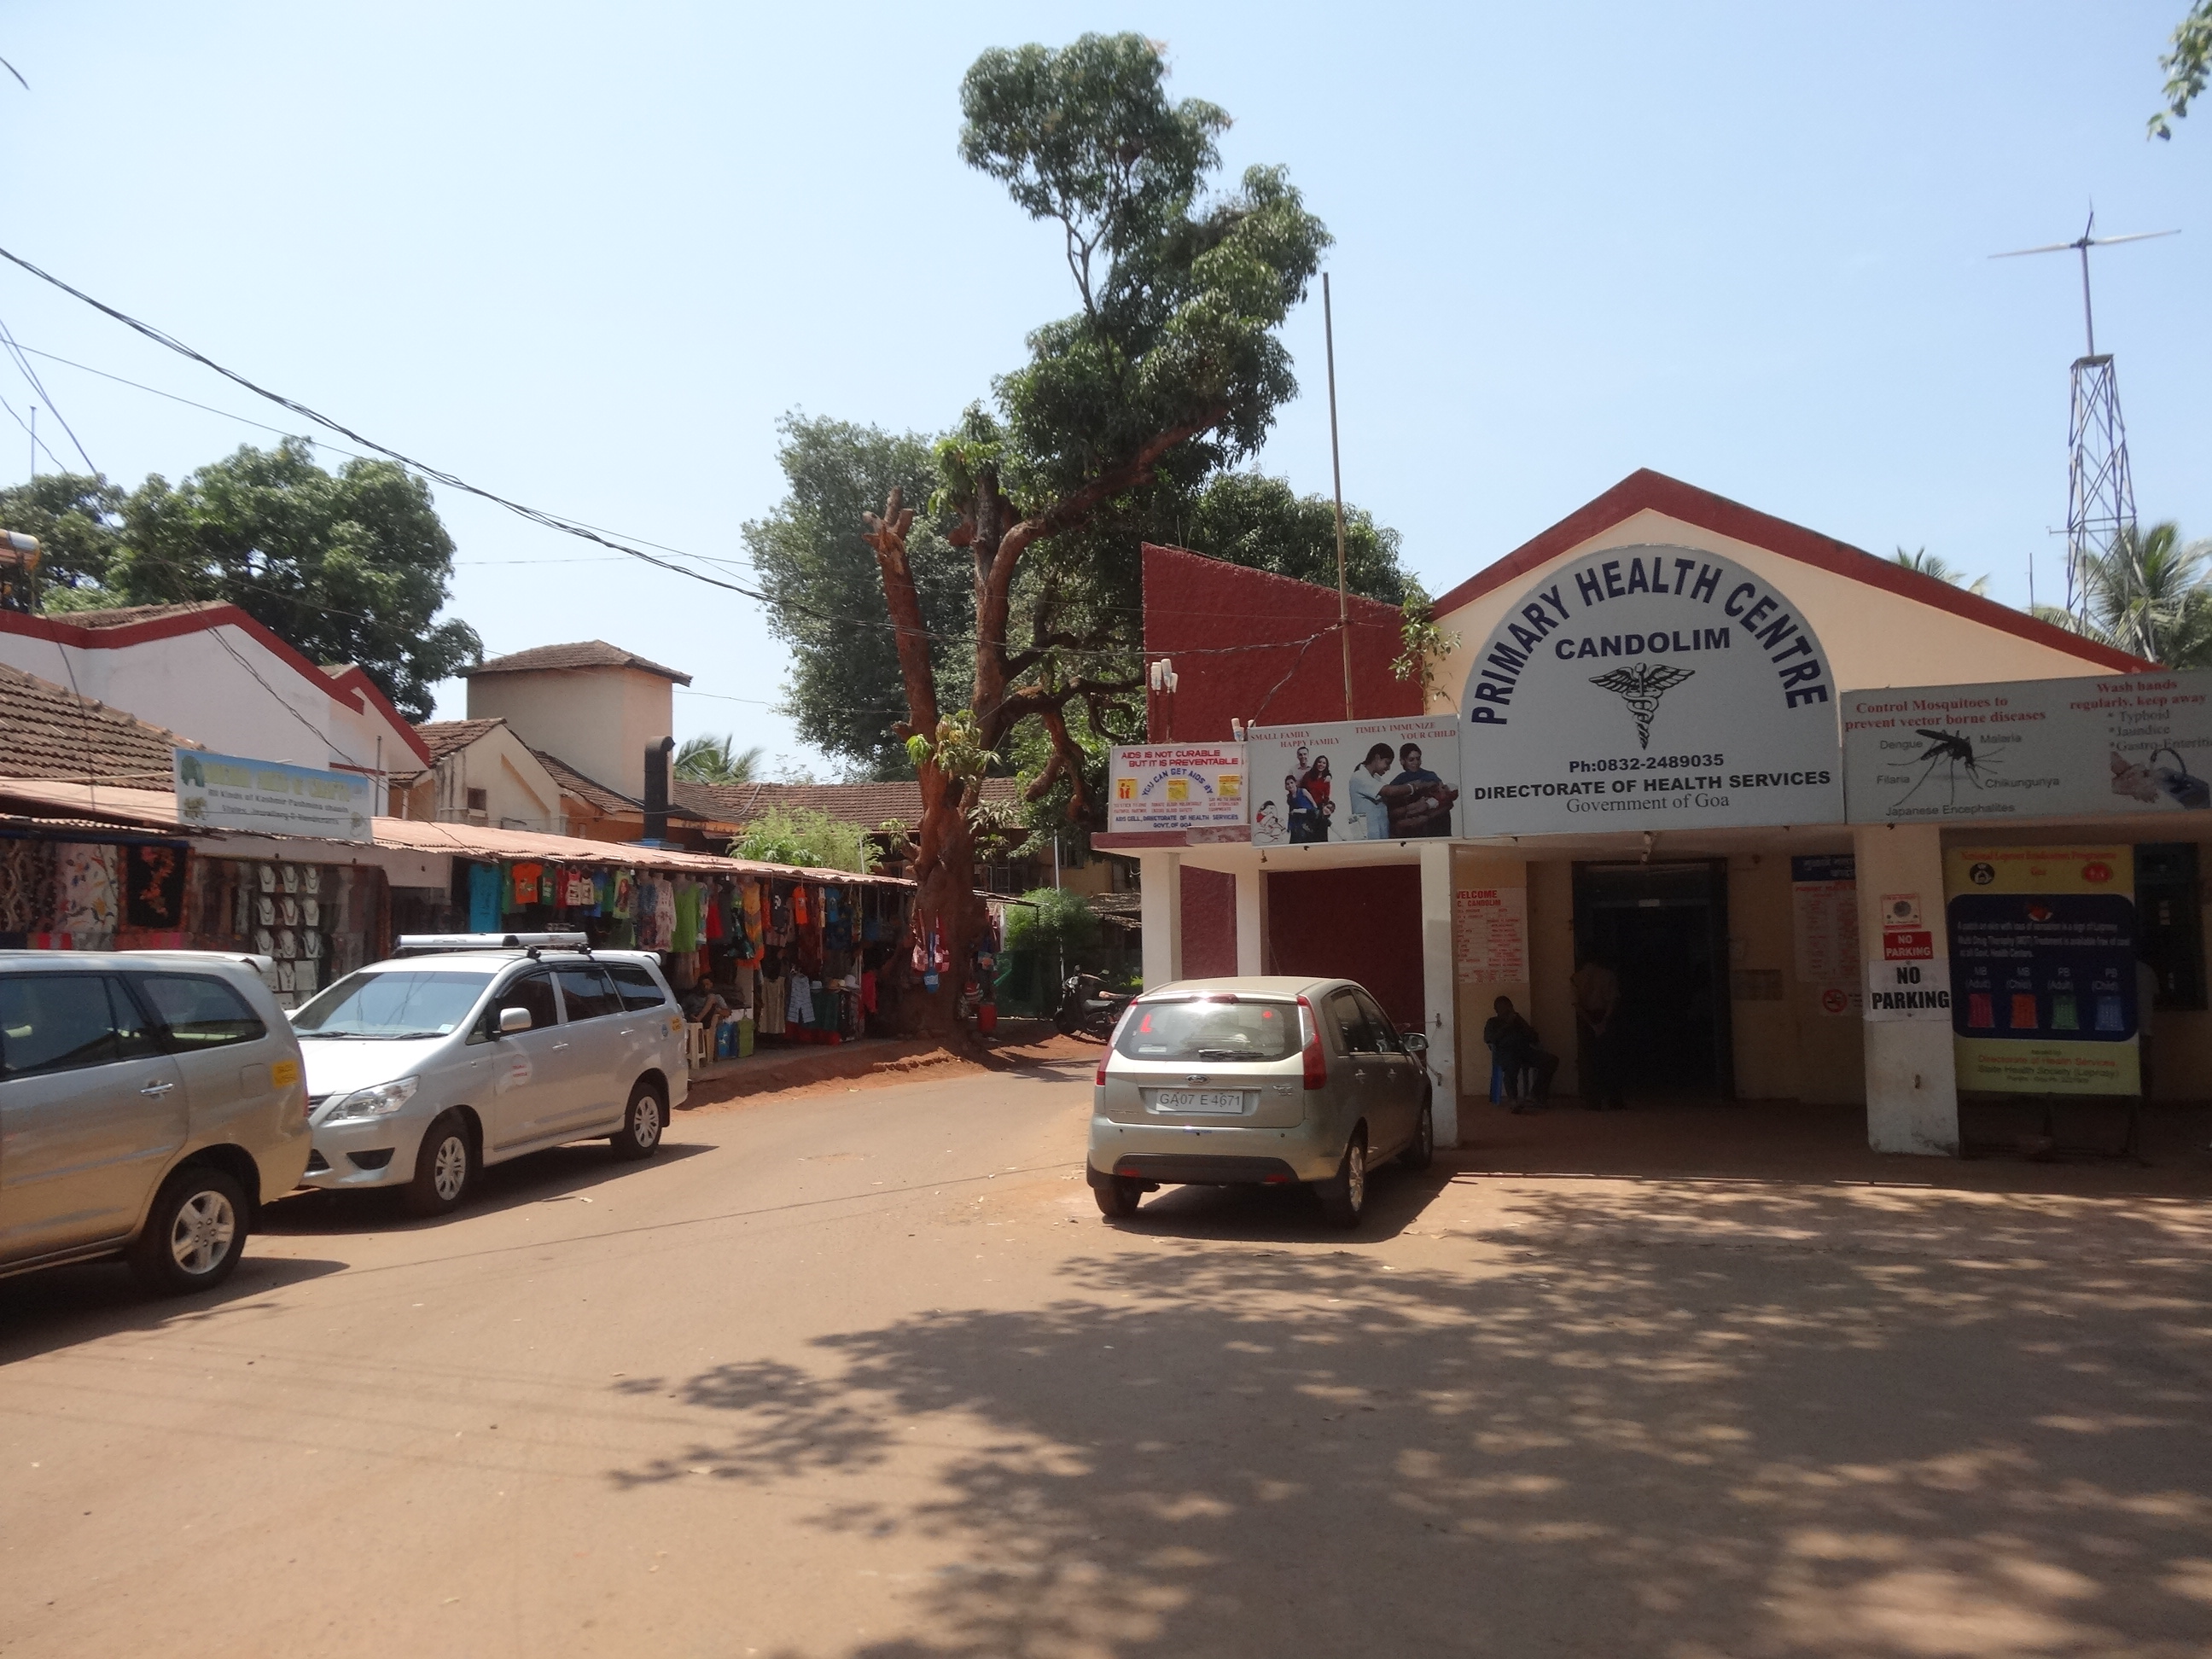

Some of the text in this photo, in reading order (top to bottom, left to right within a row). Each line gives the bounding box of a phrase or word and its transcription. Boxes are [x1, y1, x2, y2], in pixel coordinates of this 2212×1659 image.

[1471, 556, 1828, 725] PRIMARY HEALTH CENTRE
[1555, 627, 1731, 660] CANDOLIM
[2097, 679, 2178, 692] Wash hands
[1856, 696, 2008, 713] Control Mosquitoes to
[2137, 696, 2168, 707] keep
[2171, 695, 2206, 705] away
[1845, 710, 2046, 731] prevent vector borne diseases
[2120, 709, 2170, 723] Typhoid
[1355, 721, 1435, 734] TIMELY IMMUNIZE
[2116, 725, 2170, 736] Jaundice
[1250, 730, 1310, 741] SMALL FAMILY
[1400, 729, 1456, 741] YOUR CHILD
[1980, 733, 2023, 743] Malaria
[1280, 736, 1340, 748] HAPPY FAMILY
[1880, 740, 1924, 752] Dengue
[1169, 758, 1239, 766] PREVENTABLE
[1569, 754, 1725, 773] Ph:0832-2489035
[1142, 782, 1155, 796] YOU
[1154, 771, 1168, 783] CAN
[1188, 771, 1206, 784] AIDS
[1474, 771, 1831, 800] DIRECTORATE OF HEALTH SERVICES
[1877, 775, 1910, 784] Filaria
[1985, 777, 2060, 789] Chikungunya
[1566, 793, 1730, 813] Government of Goa
[1886, 806, 1940, 817] Japanese
[1897, 934, 1912, 944] NO
[1886, 947, 1931, 957] PARKING
[1896, 966, 1921, 984] NO
[1871, 990, 1950, 1010] PARKING
[1139, 1013, 1153, 1033] L
[1160, 1093, 1240, 1106] GA07 E 4671
